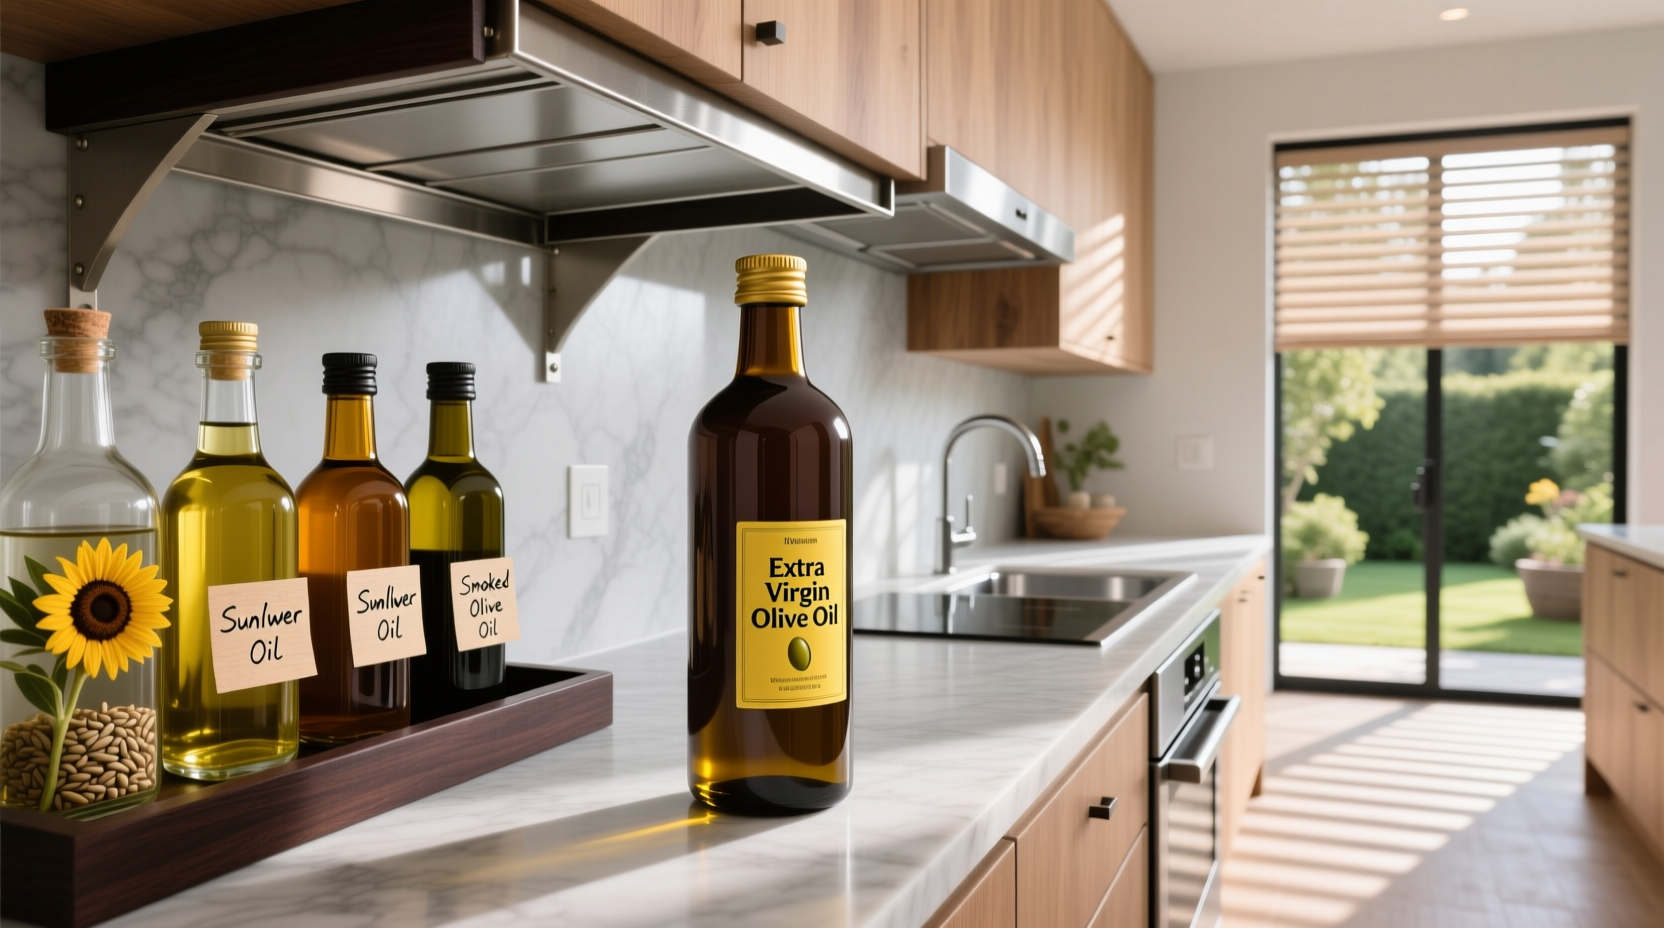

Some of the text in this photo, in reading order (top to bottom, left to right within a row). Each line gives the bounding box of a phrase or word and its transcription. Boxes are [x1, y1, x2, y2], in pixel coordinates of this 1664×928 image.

[769, 557, 825, 578] Extra
[459, 568, 509, 596] Smoked
[764, 580, 830, 608] Virgin
[469, 597, 503, 618] Olive
[750, 603, 838, 629] Olive Oil
[377, 615, 403, 641] Oil
[478, 617, 498, 639] Oil
[249, 635, 283, 665] Oil
